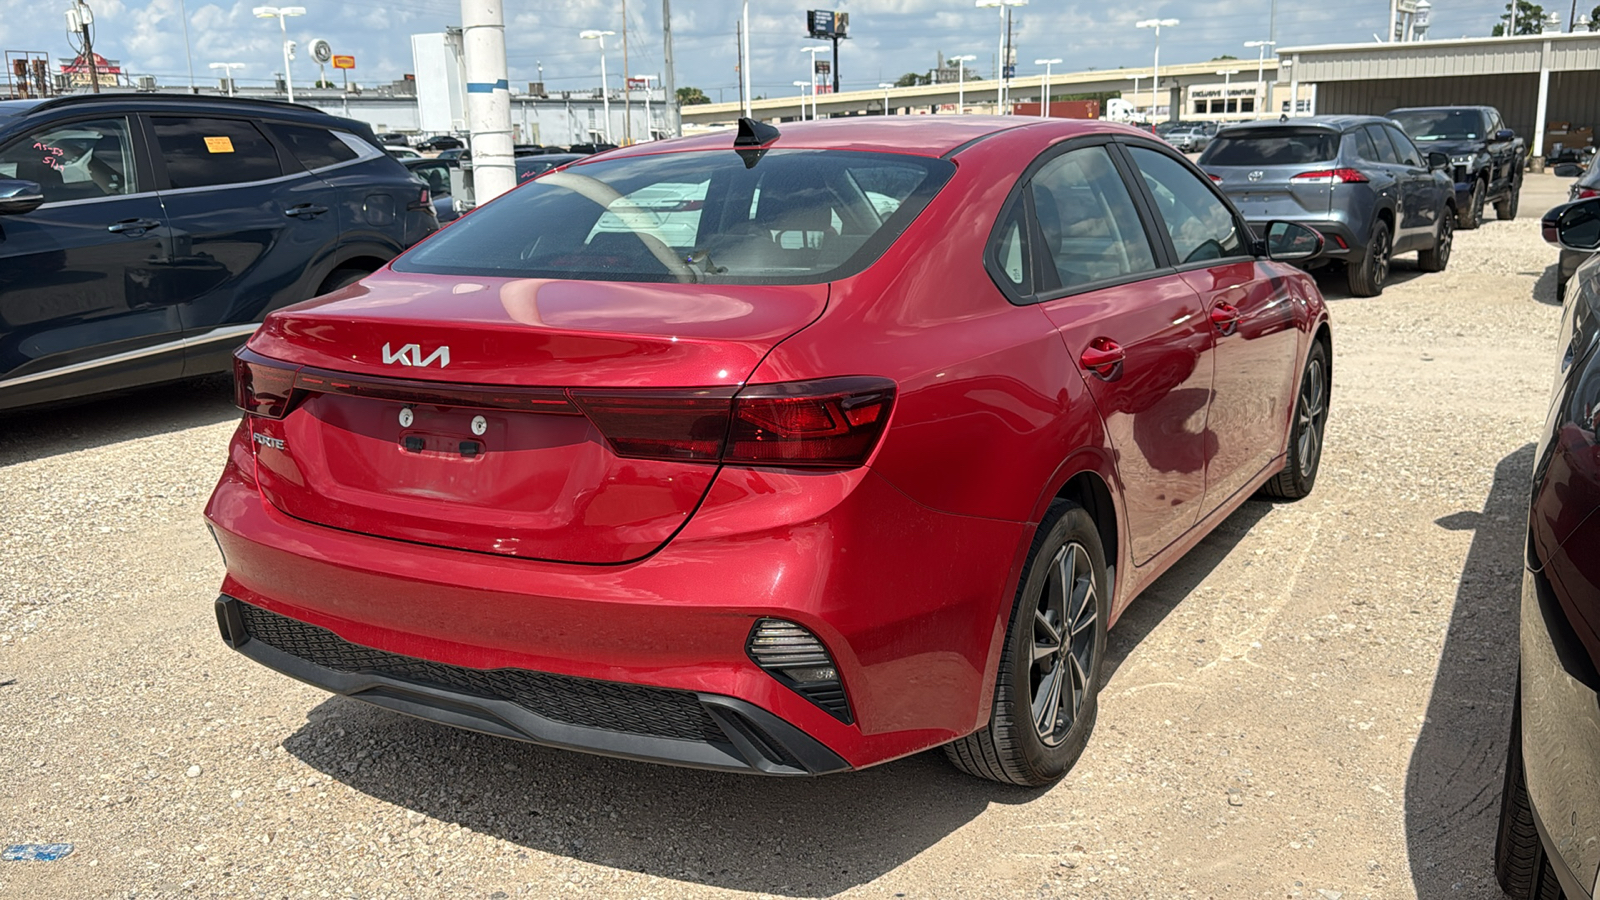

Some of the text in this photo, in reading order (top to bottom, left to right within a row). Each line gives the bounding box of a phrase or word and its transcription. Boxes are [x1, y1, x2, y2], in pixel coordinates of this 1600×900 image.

[1225, 88, 1257, 96] URNITURE
[382, 341, 450, 369] KIA
[253, 432, 285, 450] FORTE
